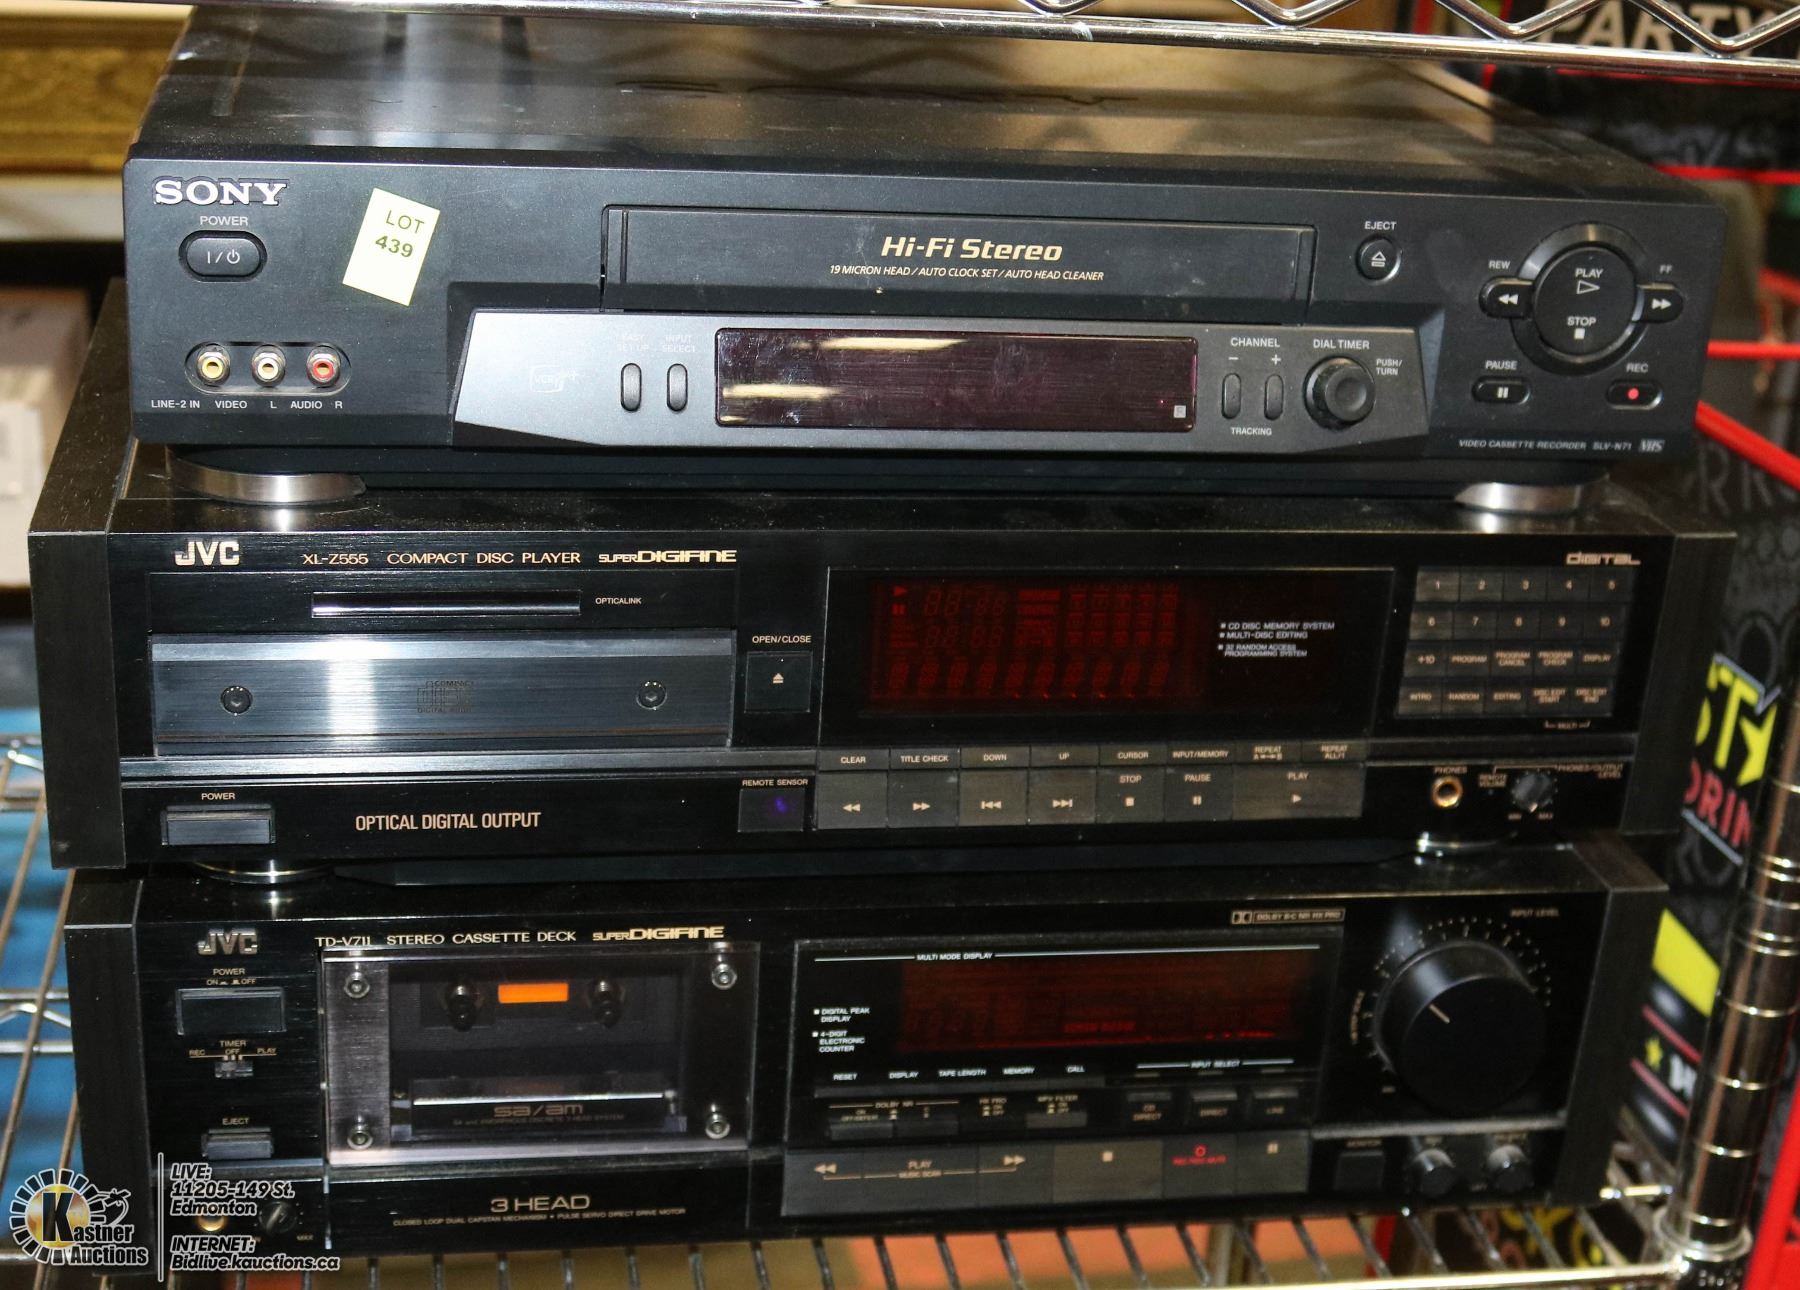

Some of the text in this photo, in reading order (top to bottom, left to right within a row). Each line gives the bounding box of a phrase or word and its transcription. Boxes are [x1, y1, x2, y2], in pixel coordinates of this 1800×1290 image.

[154, 179, 287, 206] SONY
[200, 216, 249, 226] POWER
[385, 210, 425, 234] LOT
[1364, 221, 1397, 230] EJECT
[375, 236, 413, 258] 439
[881, 237, 1063, 261] Hi-Fi Stereo
[1489, 260, 1510, 269] REW
[1660, 265, 1672, 273] FF
[830, 265, 1104, 281] 19 MICRON HEAD AUTO CLOCK SET AUTO HEAD CLEANER
[1575, 268, 1603, 277] PLAY
[1567, 317, 1596, 326] STOP
[1230, 338, 1280, 348] CHANNEL
[1313, 340, 1370, 350] DIAL TIMER
[1376, 358, 1402, 367] PUSH/
[1485, 361, 1517, 370] PAUSE
[1376, 367, 1398, 375] TURN
[1626, 364, 1648, 372] REC
[151, 400, 200, 409] LINE-2 IN
[215, 400, 247, 409] VIDEO
[270, 401, 277, 409] L
[290, 400, 322, 409] AUDIO
[335, 401, 343, 409] R
[1231, 427, 1272, 436] TRACKING
[1459, 440, 1665, 452] VIDEO CASSETTE RECORDER SLV-N71 VHS
[175, 541, 240, 566] JVC
[303, 553, 368, 565] XL-Z555
[387, 553, 469, 564] COMPACT
[476, 553, 514, 564] DISC
[522, 552, 581, 564] PLAYER
[1436, 581, 1440, 589] 1
[1479, 581, 1485, 590] 2
[1522, 581, 1529, 589] 3
[1566, 580, 1572, 589] 4
[595, 597, 642, 605] OPTICALINK
[1428, 617, 1435, 626] 6
[1472, 617, 1479, 625] 7
[1516, 617, 1522, 626] 8
[1559, 617, 1565, 626] 9
[1601, 617, 1610, 626] 10
[1263, 622, 1299, 630] MEMORY
[1303, 622, 1335, 630] SYSTEM
[752, 635, 811, 643] OPEN/CLOSE
[1226, 631, 1308, 639] MULTI-DISC EDITING
[1451, 655, 1488, 663] PROGRAM
[1538, 651, 1573, 659] PROGRAM
[901, 755, 949, 763] TITLE CHECK
[1173, 751, 1229, 759] INPUT/MEMORY
[840, 756, 866, 764] CLEAR
[1120, 775, 1142, 783] STOP
[1185, 774, 1211, 782] PAUSE
[1288, 772, 1308, 780] PLAY
[201, 793, 235, 801] POWER
[355, 812, 541, 831] OPTICAL DIGITAL OUTPUT
[197, 928, 258, 955] JVC
[387, 934, 444, 945] STEREO
[452, 933, 530, 944] CASSETTE
[537, 932, 577, 942] DECK
[213, 968, 245, 976] POWER
[819, 1037, 865, 1045] ELECTRONIC
[257, 1047, 277, 1055] PLAY
[1003, 1067, 1035, 1075] MEMORY
[833, 1073, 857, 1081] RESET
[222, 1117, 249, 1125] EJECT
[908, 1161, 932, 1169] PLAY
[490, 1195, 590, 1213] 3 HEAD
[393, 1218, 422, 1227] CLOSED
[446, 1217, 466, 1225] DUAL
[468, 1216, 501, 1224] CAPSTAN
[659, 1209, 686, 1217] MOTOR
